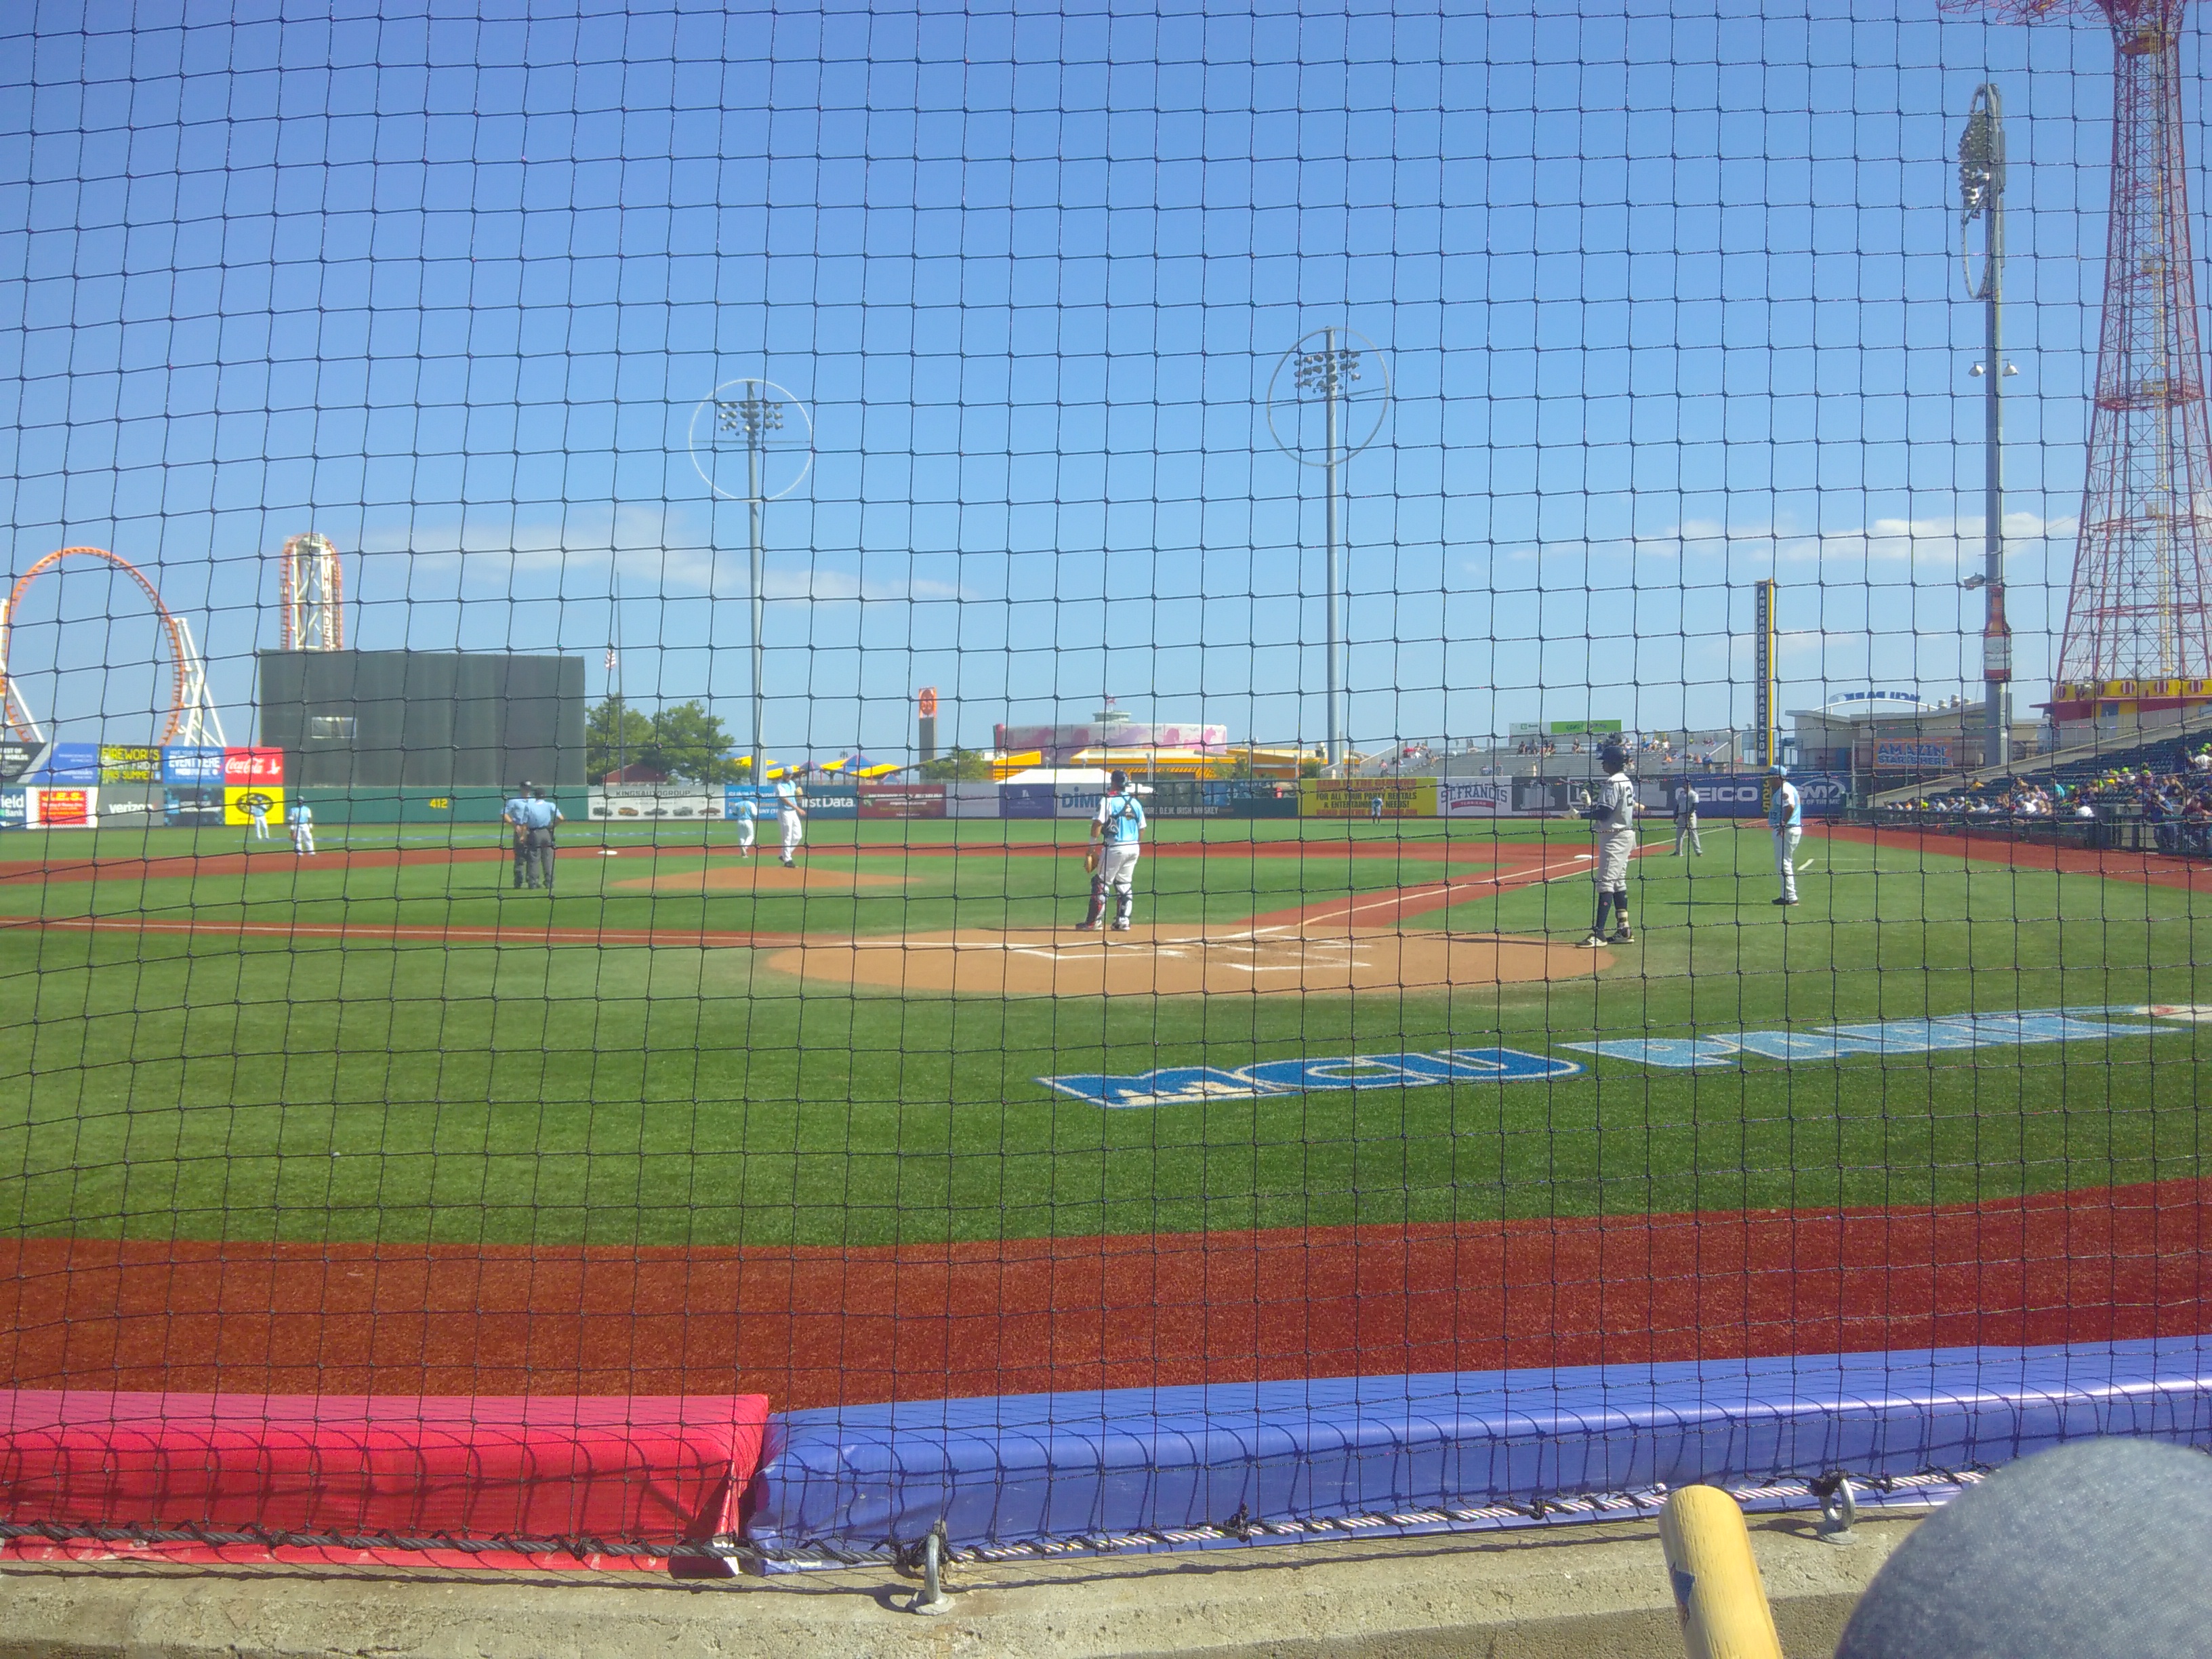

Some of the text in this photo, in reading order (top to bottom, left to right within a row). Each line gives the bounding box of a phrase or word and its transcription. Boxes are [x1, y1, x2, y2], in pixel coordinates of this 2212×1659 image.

[429, 798, 449, 808] 412
[1193, 806, 1218, 815] WHSKEY
[1035, 1014, 2189, 1109] MCU PARK
